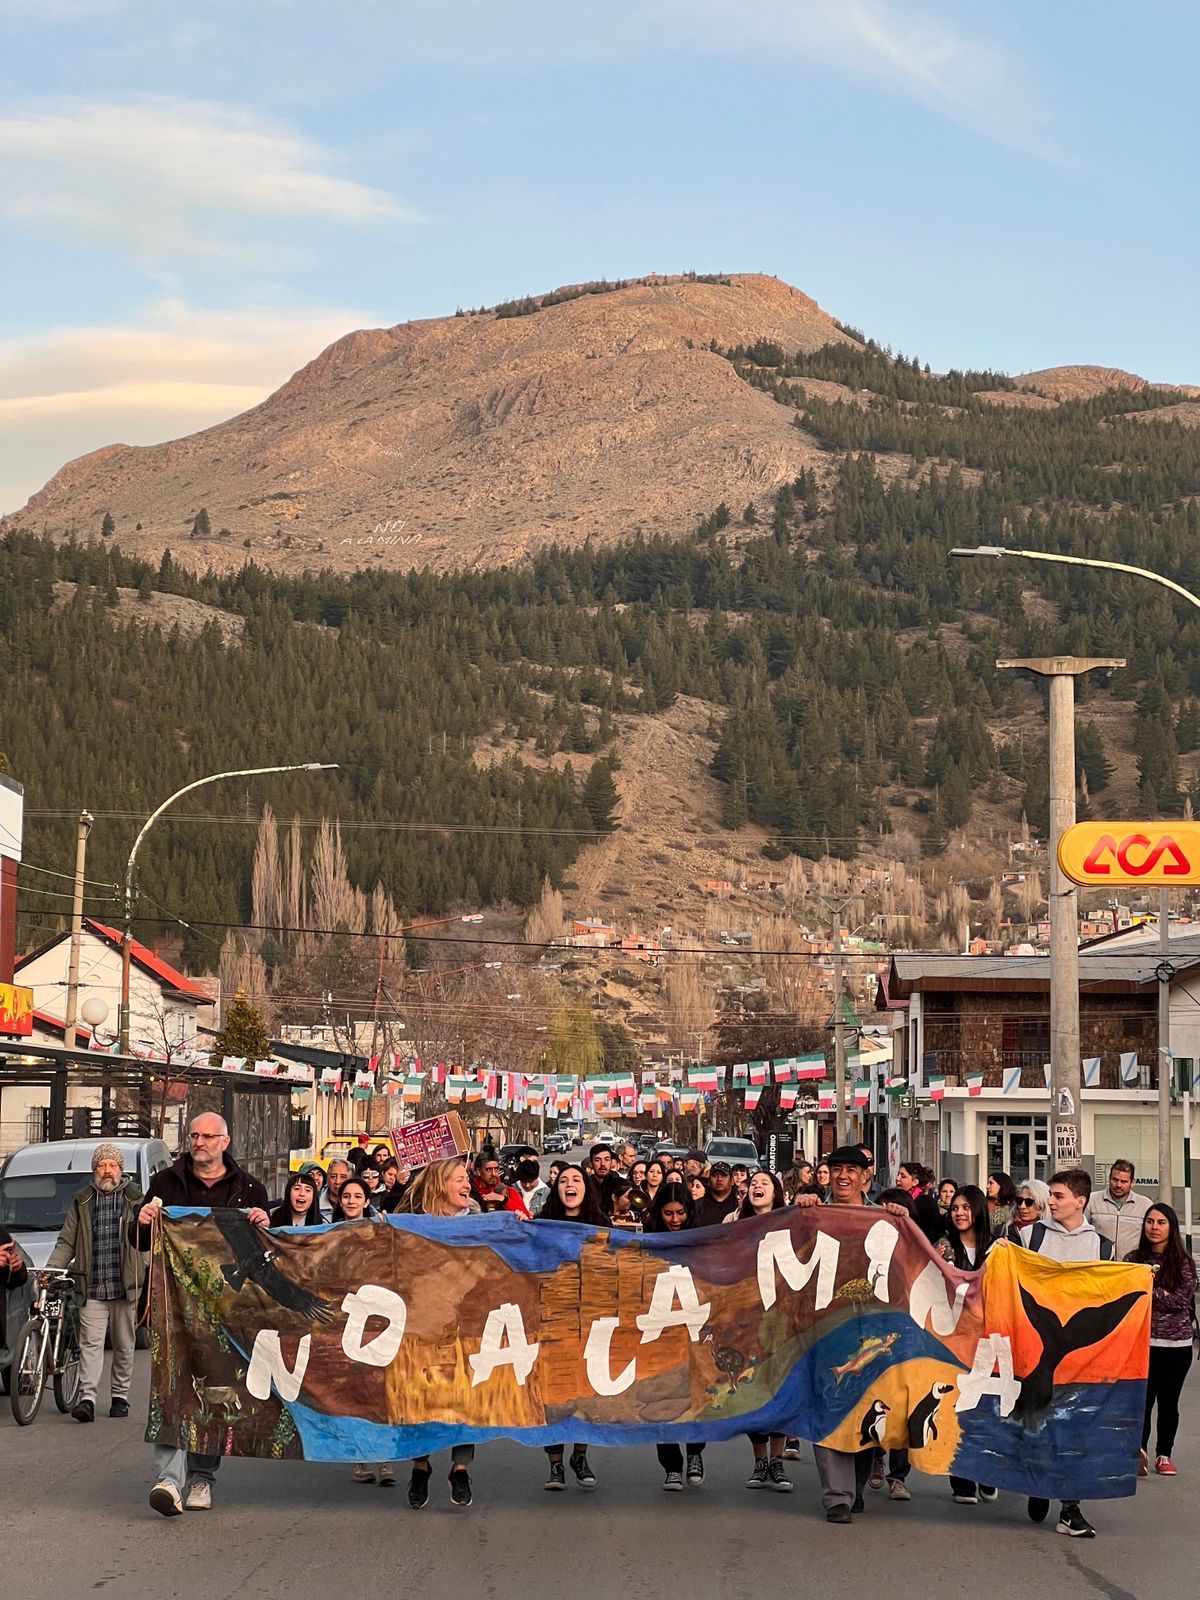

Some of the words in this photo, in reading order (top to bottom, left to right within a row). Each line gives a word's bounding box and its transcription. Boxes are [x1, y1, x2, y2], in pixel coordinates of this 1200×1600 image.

[373, 520, 406, 533] NO
[357, 536, 373, 545] LA
[377, 533, 422, 545] MINA
[1083, 834, 1191, 876] ACA
[1057, 1136, 1076, 1147] MAT
[769, 1134, 777, 1175] BORATORIO
[1057, 1146, 1081, 1160] ANIMA
[246, 1285, 407, 1402] NO
[469, 1303, 539, 1388] A
[584, 1264, 711, 1397] LA
[757, 1219, 1022, 1417] MINA
